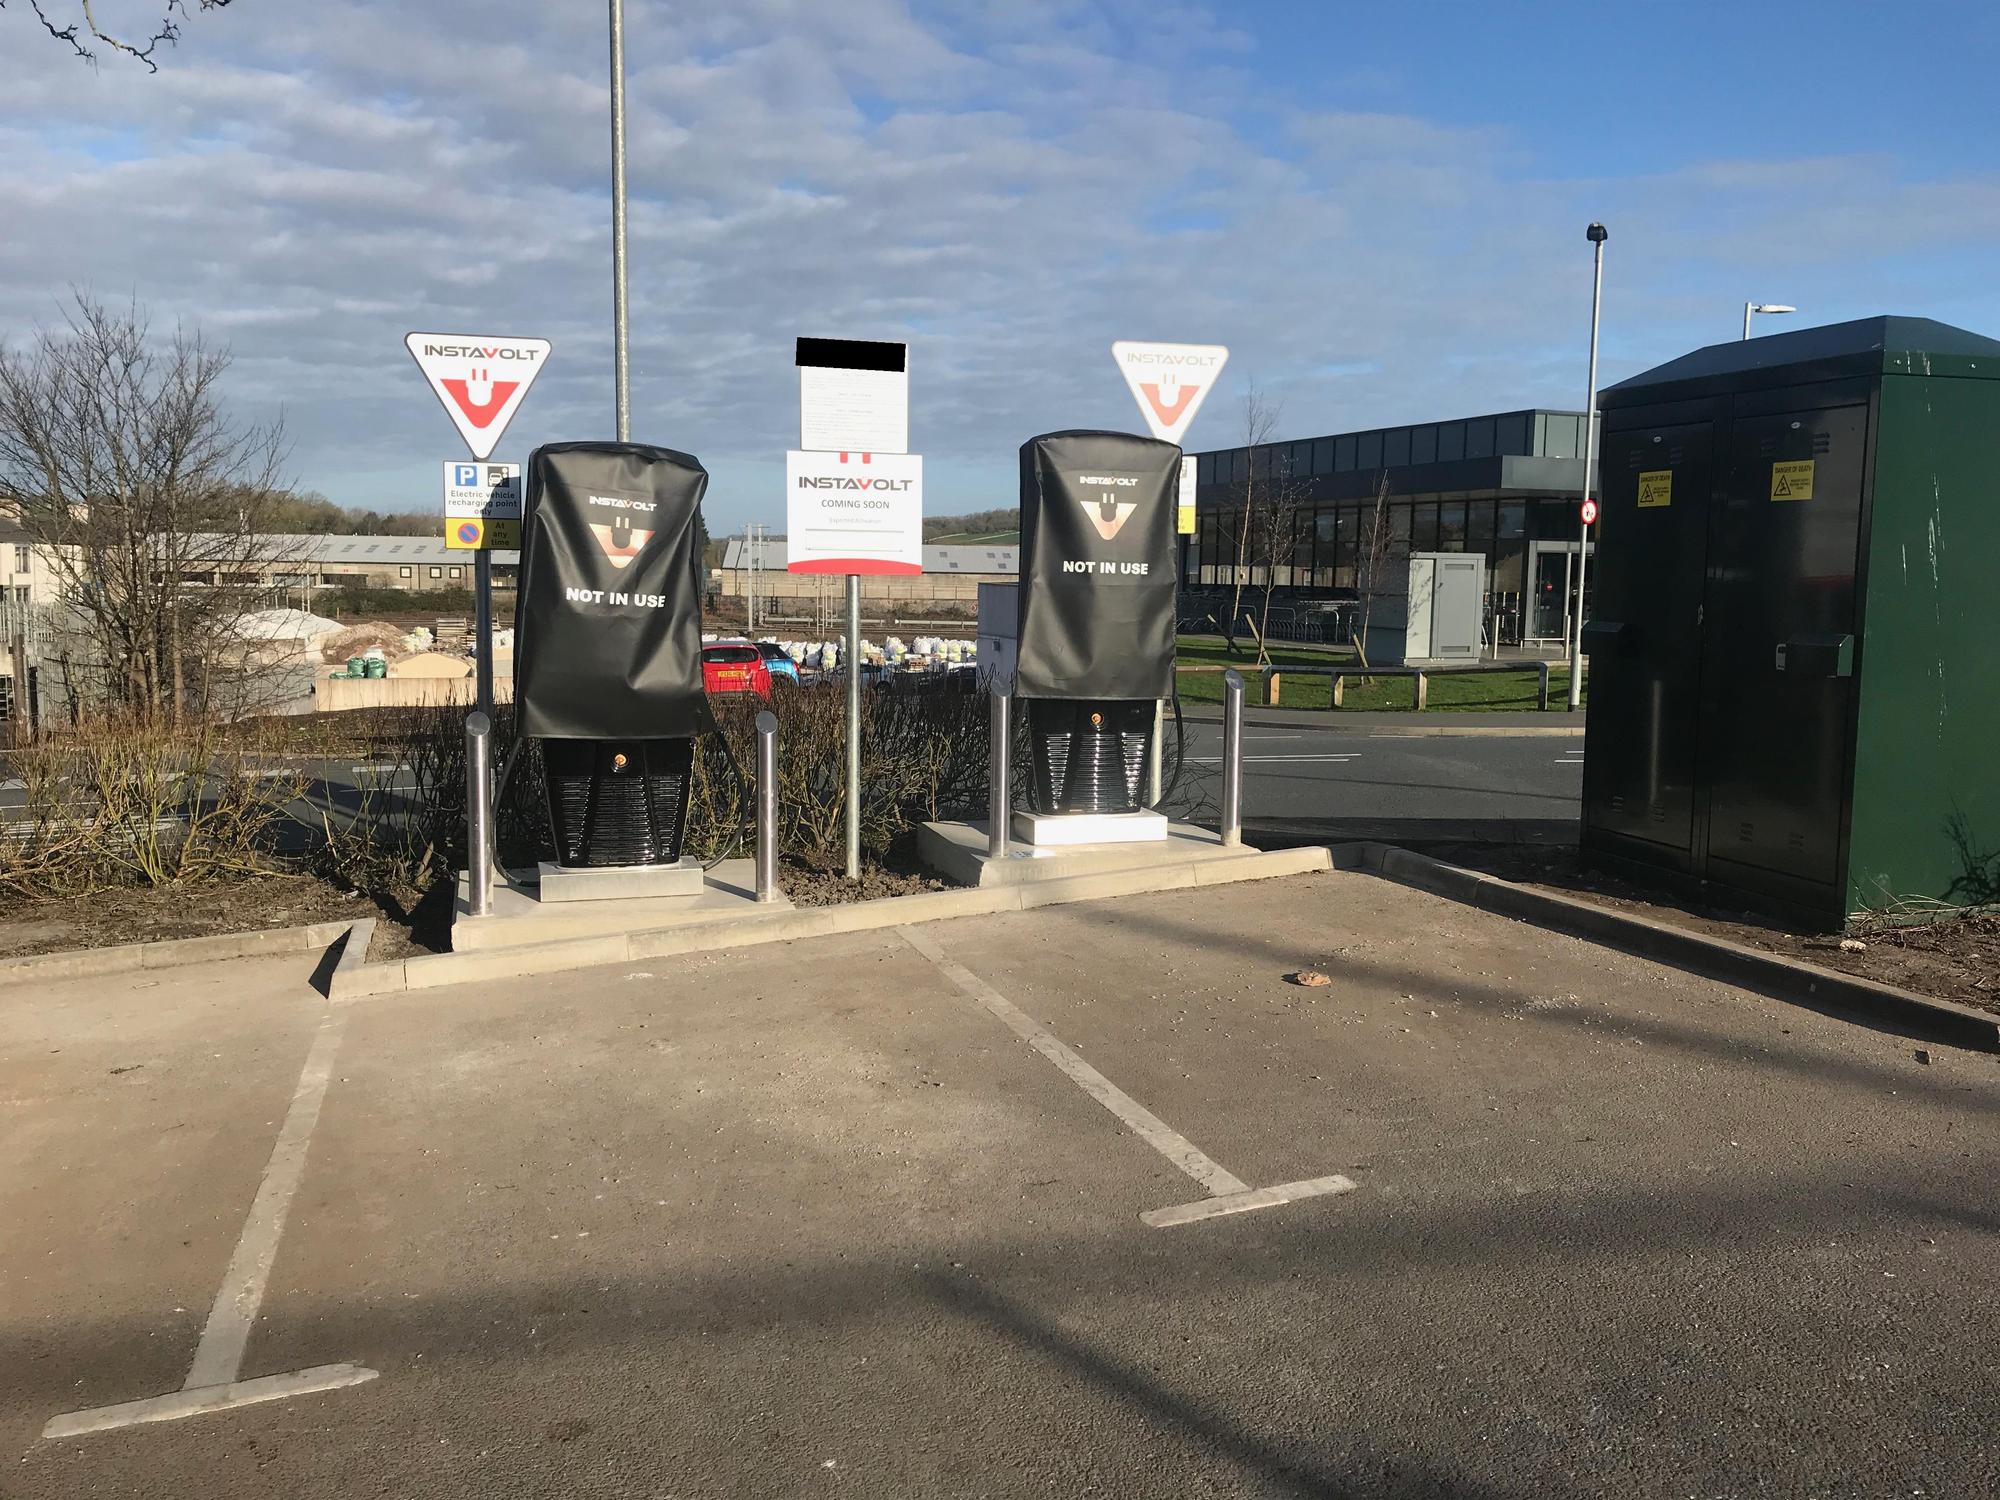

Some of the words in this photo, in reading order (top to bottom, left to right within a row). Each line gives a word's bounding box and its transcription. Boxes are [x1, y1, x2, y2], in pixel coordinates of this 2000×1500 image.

[424, 344, 539, 361] INSTAVOLT
[1127, 352, 1217, 367] INSTAVOLT
[798, 476, 914, 491] INSTAVOLT
[1079, 475, 1139, 487] INSTAVOLT
[450, 490, 484, 498] Electric
[485, 491, 516, 499] vehicle
[448, 499, 493, 508] recharging
[495, 500, 518, 508] point
[588, 495, 658, 512] INSTAVOLT
[821, 499, 861, 509] COMING
[863, 500, 890, 509] SOON
[495, 521, 505, 530] At
[492, 531, 508, 539] any
[1063, 560, 1096, 574] NOT
[1100, 561, 1116, 574] IN
[1120, 562, 1149, 575] USE
[566, 587, 605, 604] NOT
[609, 591, 629, 606] IN
[634, 593, 666, 608] USE
